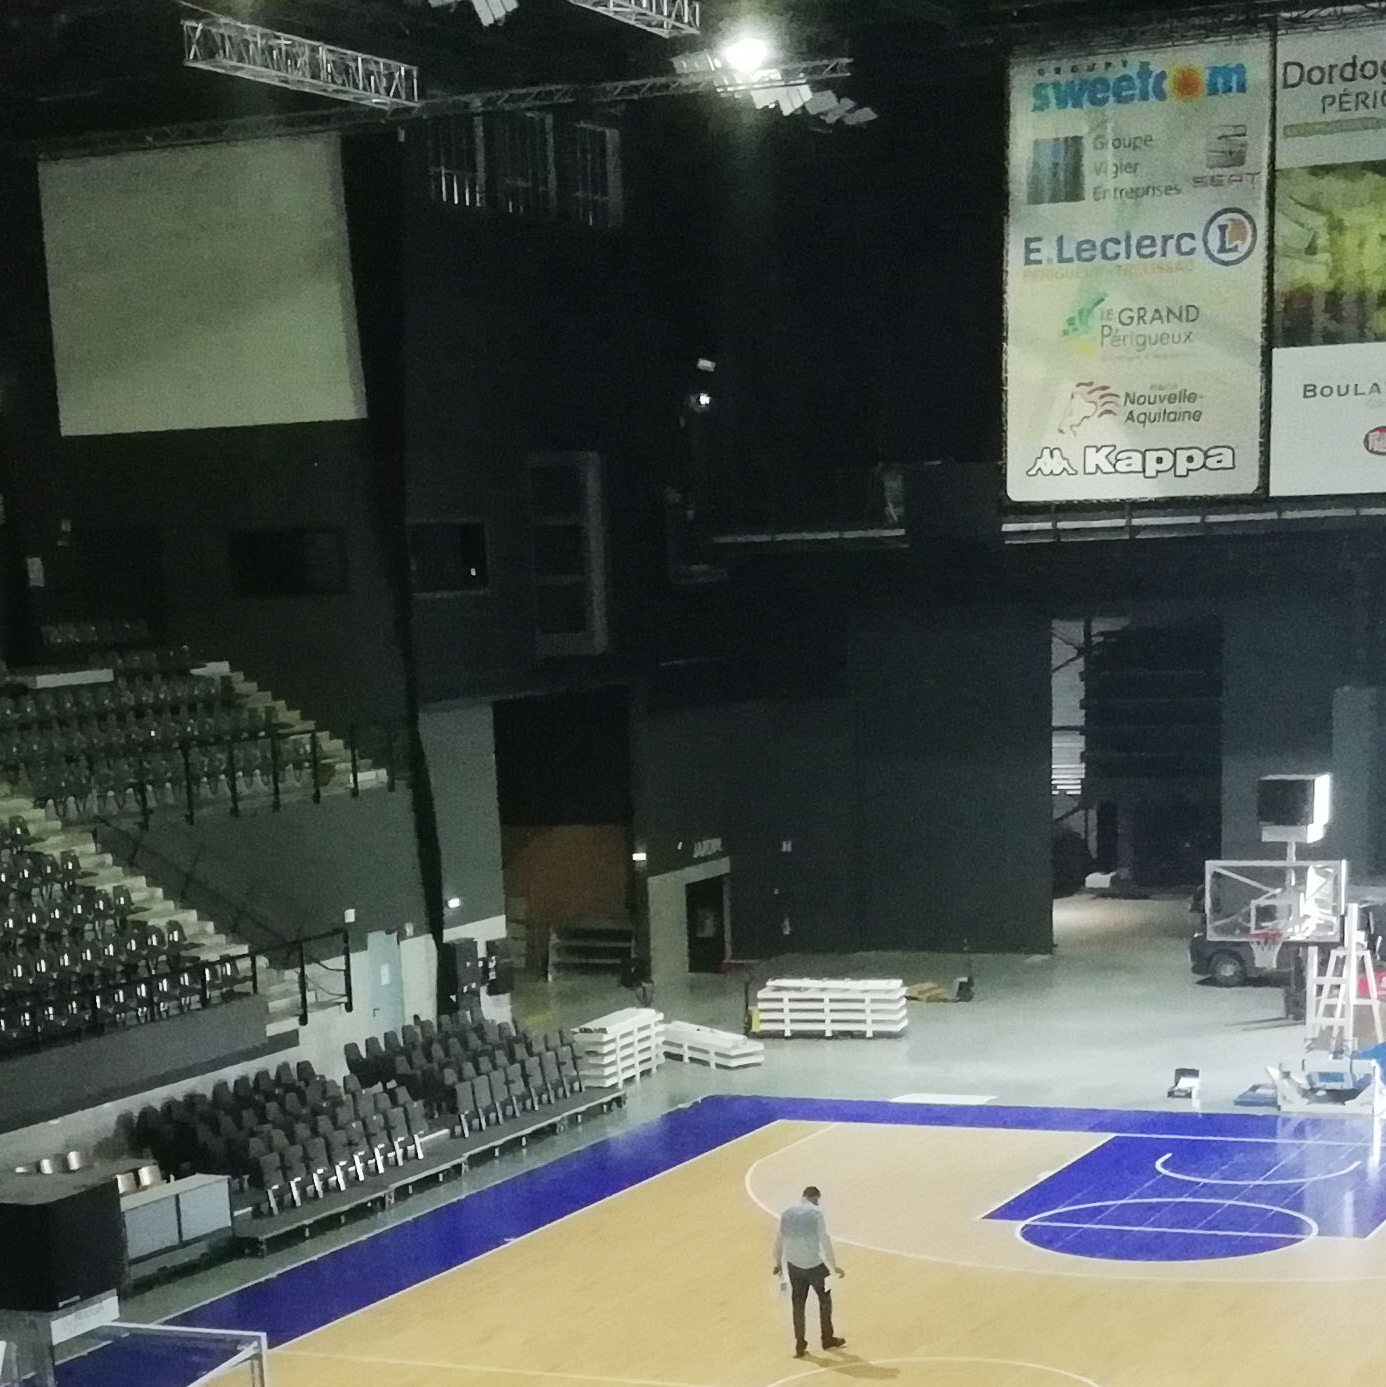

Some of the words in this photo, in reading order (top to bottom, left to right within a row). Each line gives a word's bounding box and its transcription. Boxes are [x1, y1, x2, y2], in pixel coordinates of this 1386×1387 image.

[1093, 134, 1154, 152] Groupe
[1023, 230, 1197, 266] E.Leclerc
[1118, 304, 1200, 326] GRAND
[1100, 324, 1194, 352] Périgueux
[1124, 408, 1203, 428] Aquitaine
[1083, 444, 1236, 478] Kappa
